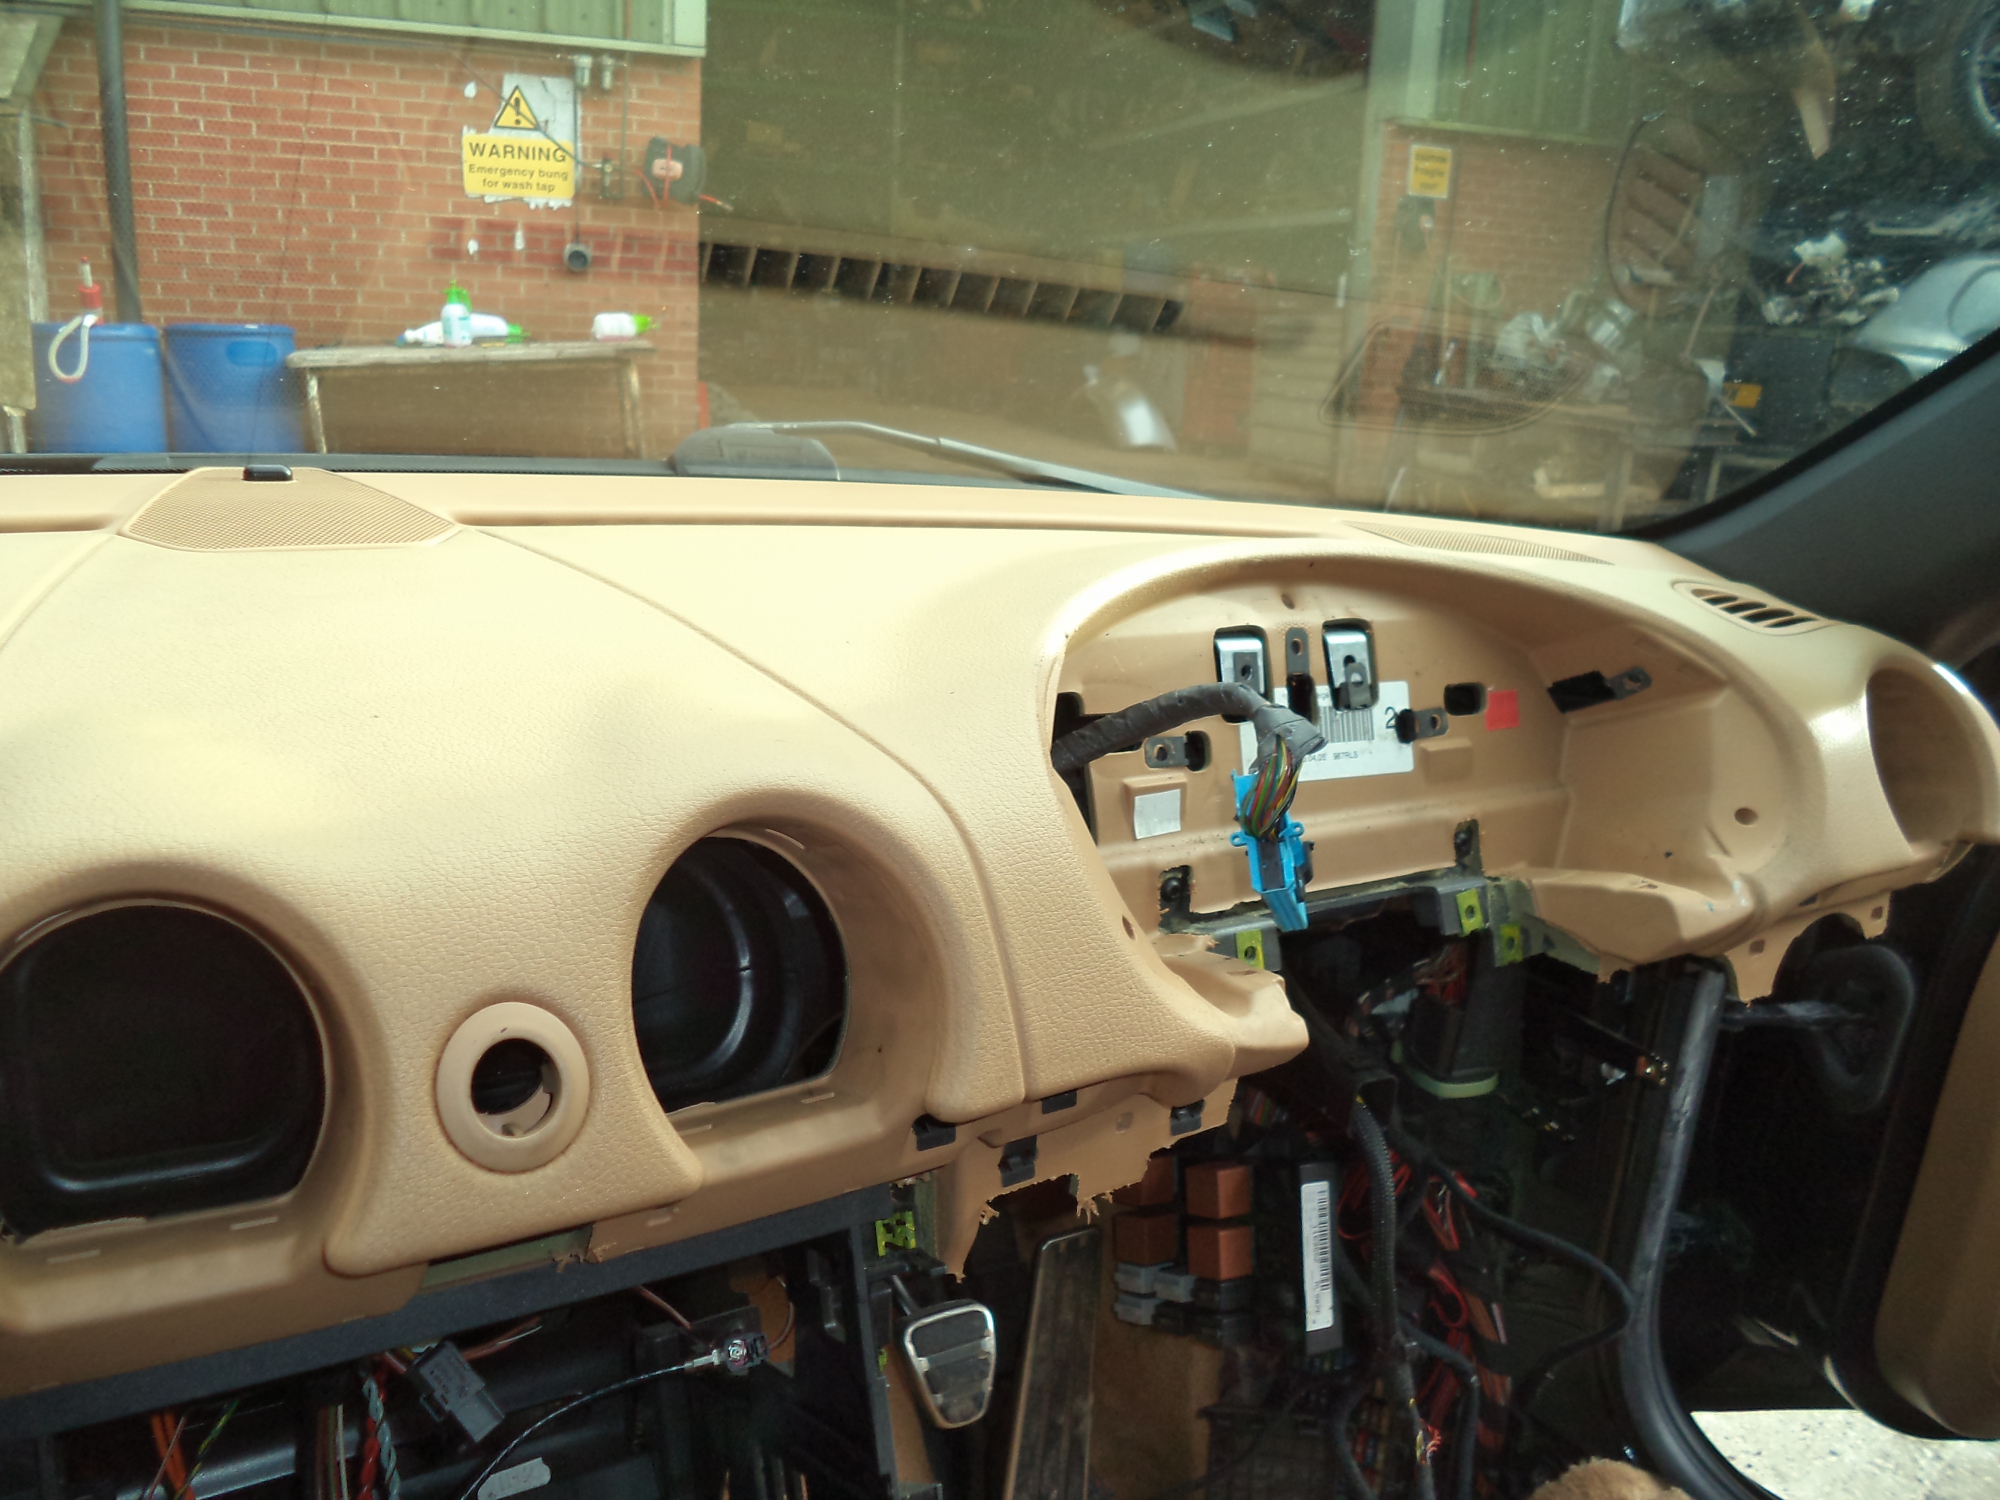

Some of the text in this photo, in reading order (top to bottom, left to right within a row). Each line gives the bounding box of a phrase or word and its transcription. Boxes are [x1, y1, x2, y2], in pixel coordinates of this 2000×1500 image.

[468, 142, 566, 163] WARNING
[468, 163, 569, 182] Emergency bung
[482, 178, 556, 193] for wash tap
